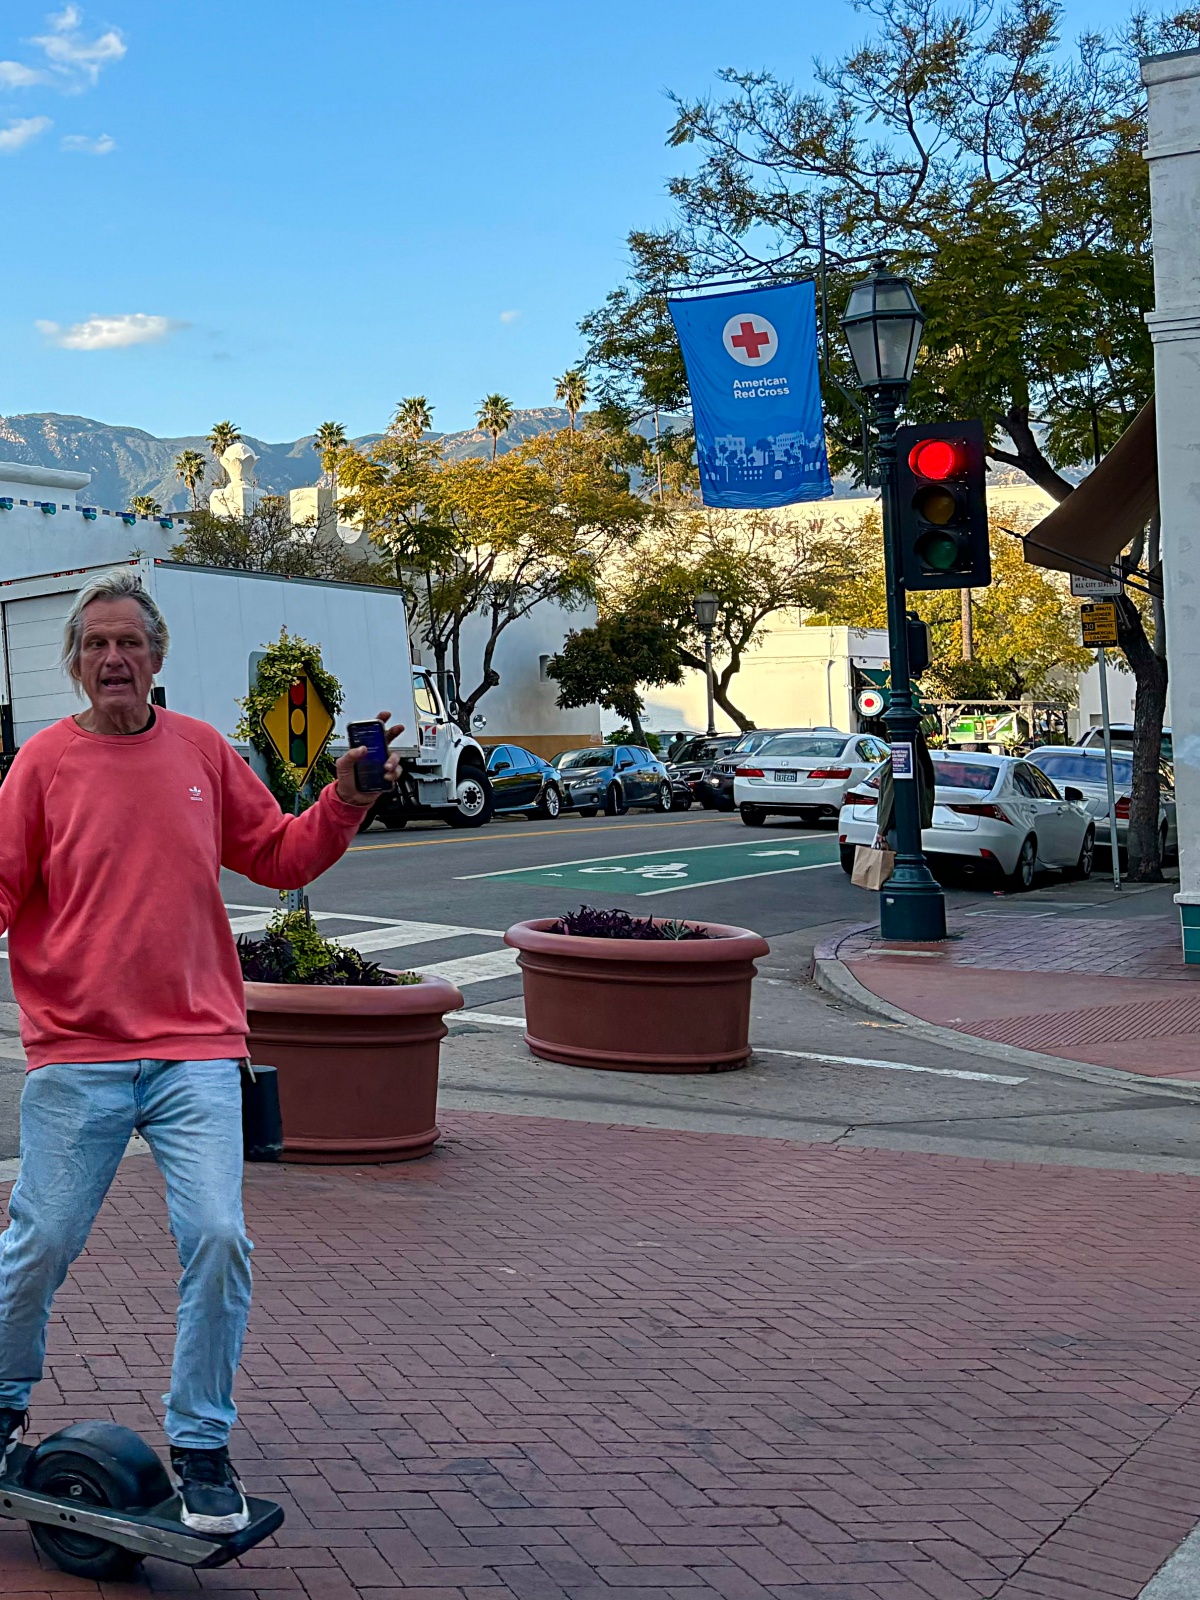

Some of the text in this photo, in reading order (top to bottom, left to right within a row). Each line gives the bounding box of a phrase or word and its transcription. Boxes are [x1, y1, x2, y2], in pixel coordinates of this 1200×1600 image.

[733, 377, 787, 389] American
[733, 387, 790, 399] Red Cross
